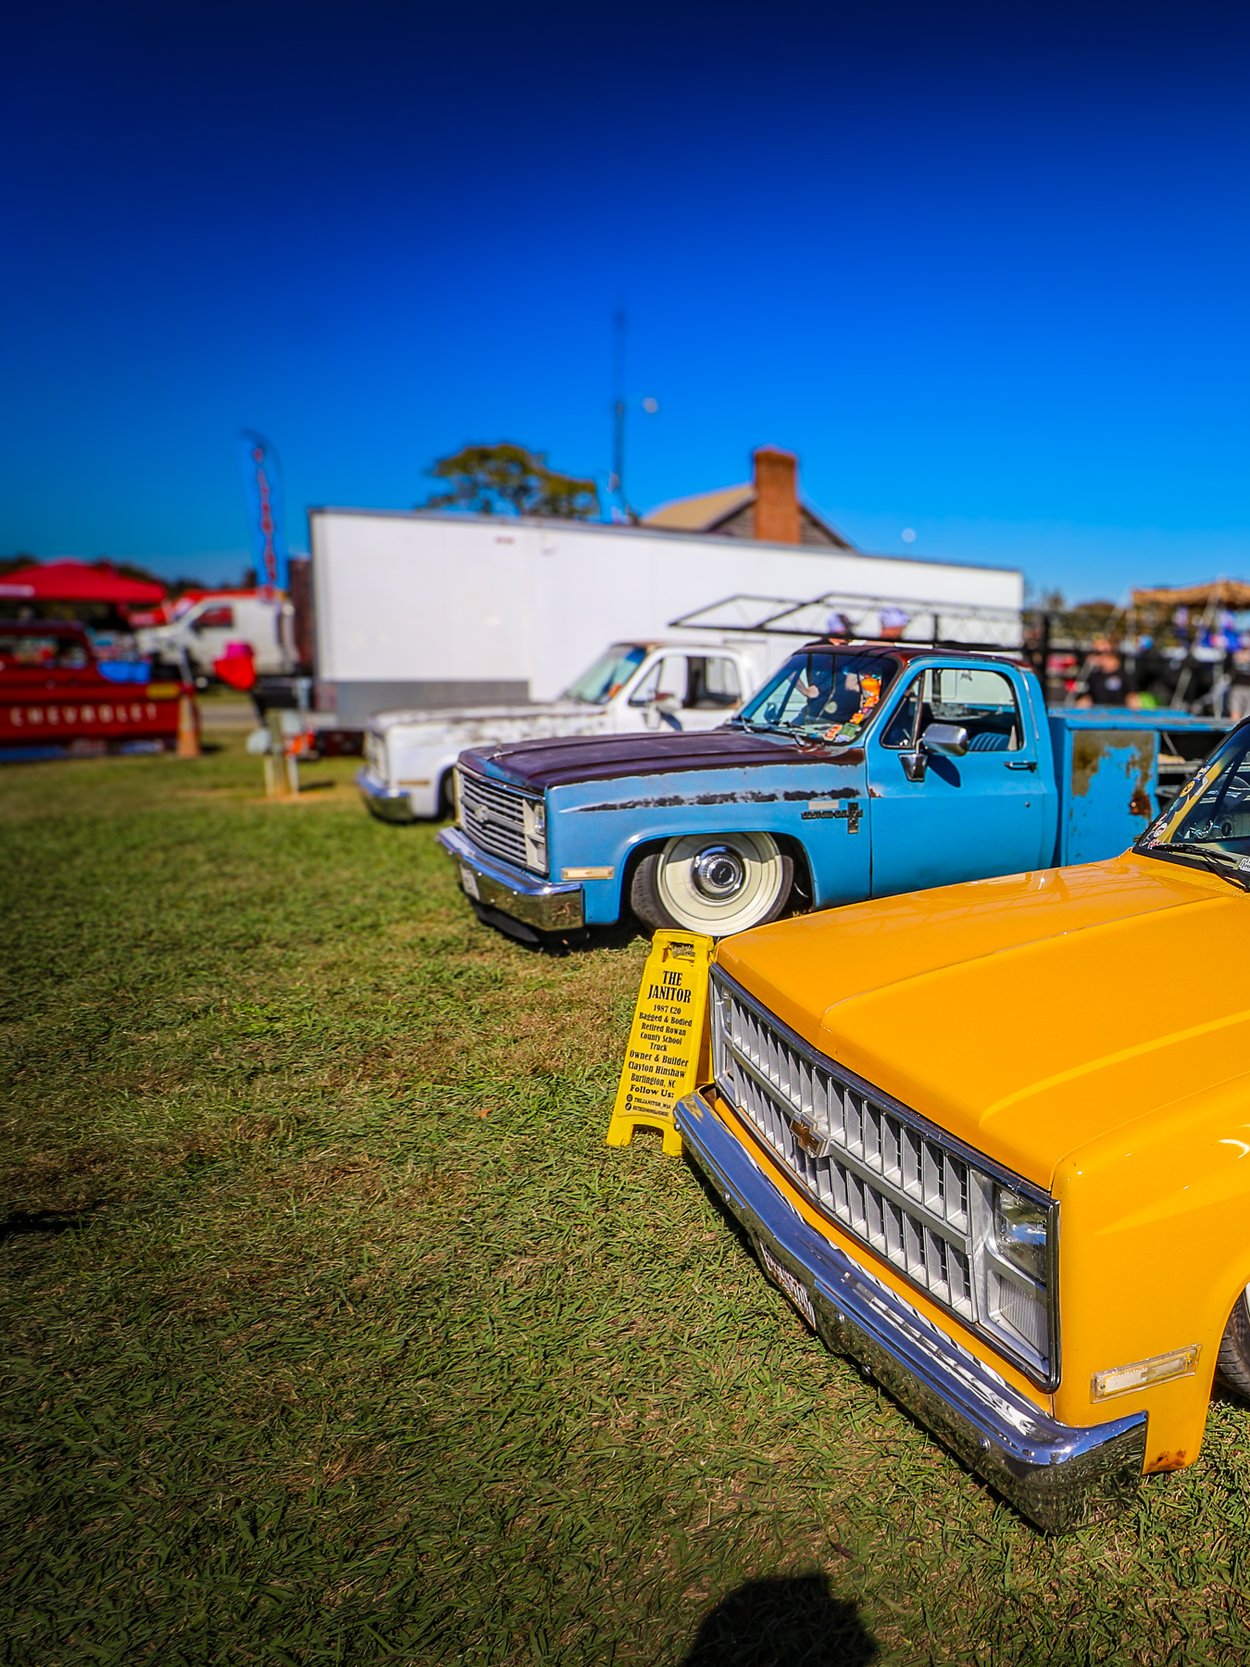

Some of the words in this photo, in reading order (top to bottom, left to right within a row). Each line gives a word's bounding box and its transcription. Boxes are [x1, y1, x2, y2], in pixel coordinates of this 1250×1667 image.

[9, 702, 158, 728] CHEVROLET
[663, 970, 683, 986] THE
[647, 984, 691, 1004] JANITOR
[654, 1004, 669, 1013] 1987
[670, 1006, 682, 1015] C20
[639, 1012, 662, 1023] Bagged
[664, 1015, 669, 1023] &
[671, 1016, 693, 1027] Bodied
[641, 1022, 664, 1032] Retired
[665, 1026, 686, 1036] Rowan
[640, 1031, 661, 1042] County
[662, 1035, 683, 1046] School
[650, 1042, 668, 1052] Truck
[630, 1050, 652, 1061] Owner
[654, 1054, 660, 1062] &
[662, 1055, 689, 1067] Builder
[628, 1060, 654, 1072] Clayton
[655, 1065, 686, 1078] Hinshaw
[630, 1084, 658, 1095] Follow
[661, 1089, 674, 1098] Us:
[668, 1079, 676, 1088] NC
